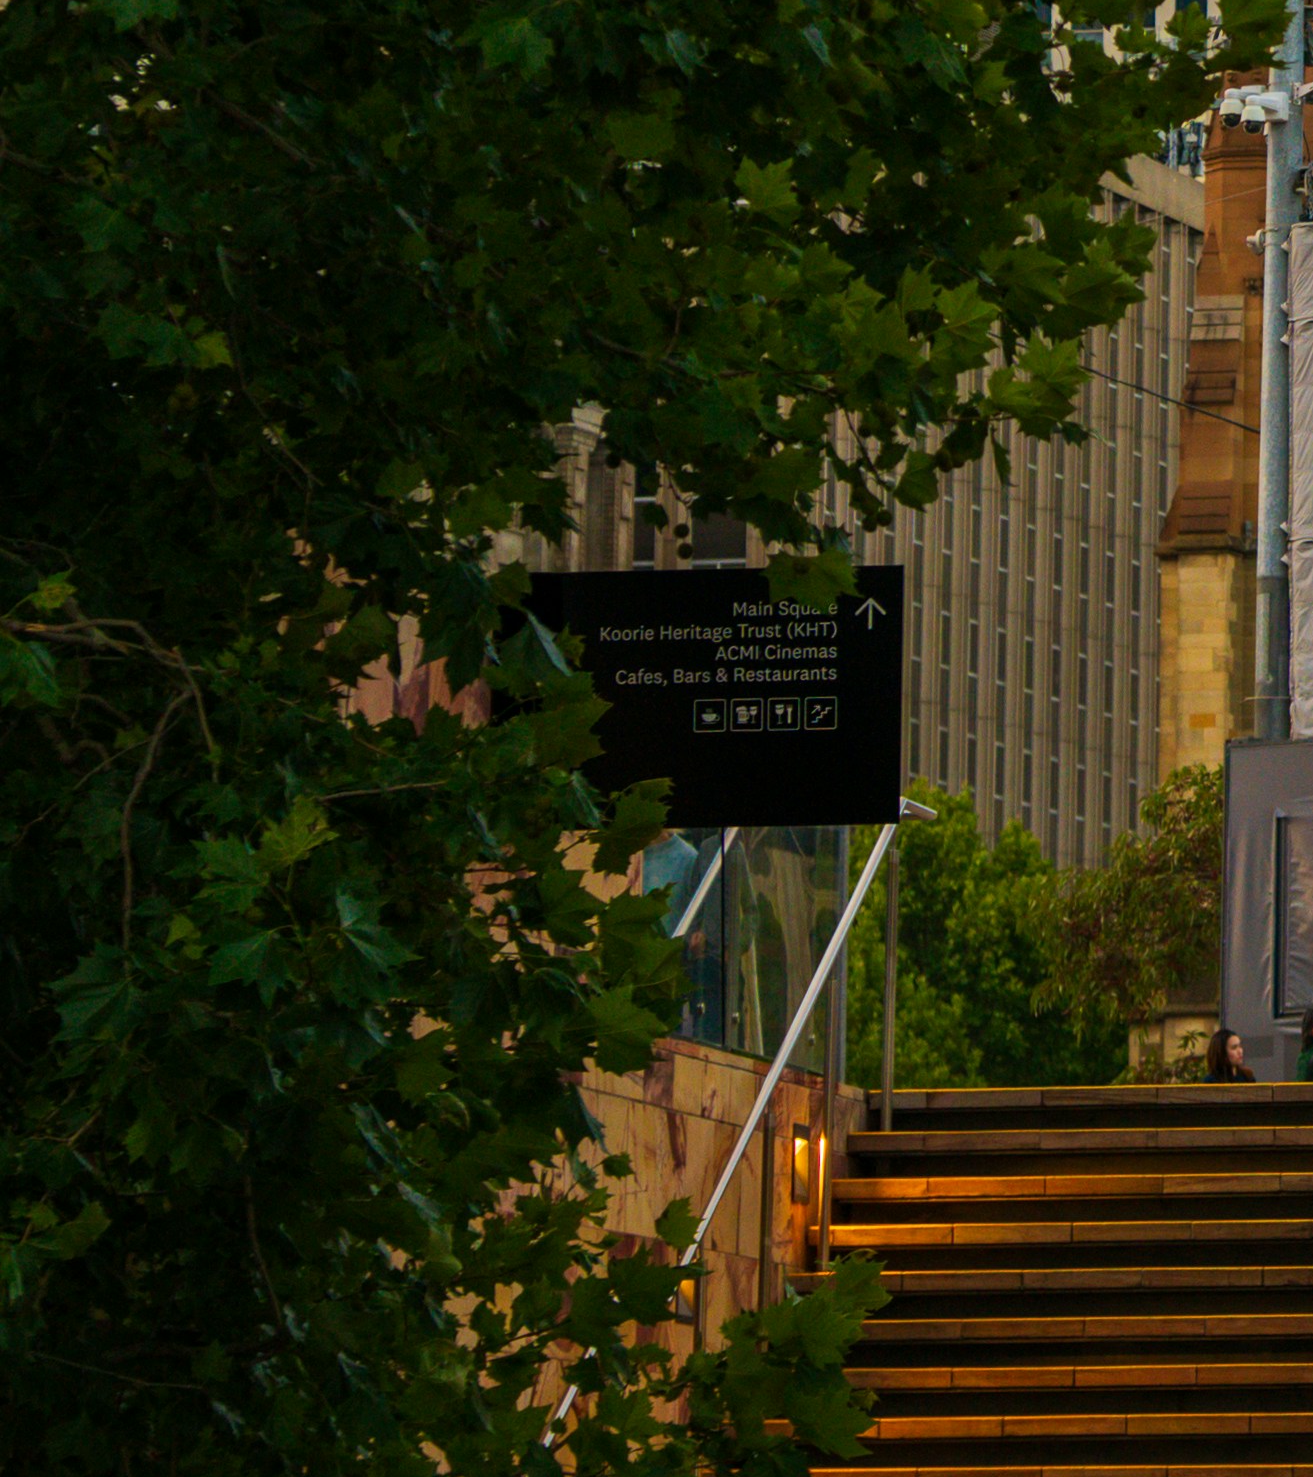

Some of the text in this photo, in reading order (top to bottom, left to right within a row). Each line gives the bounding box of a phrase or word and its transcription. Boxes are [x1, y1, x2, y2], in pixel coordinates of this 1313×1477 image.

[733, 600, 838, 619] Main Squae
[599, 620, 838, 643] Koorie Heritage Trust (KHT)
[715, 643, 838, 661] ACMI Cinemas
[615, 666, 838, 687] Cafes, Bars & Restaurants
